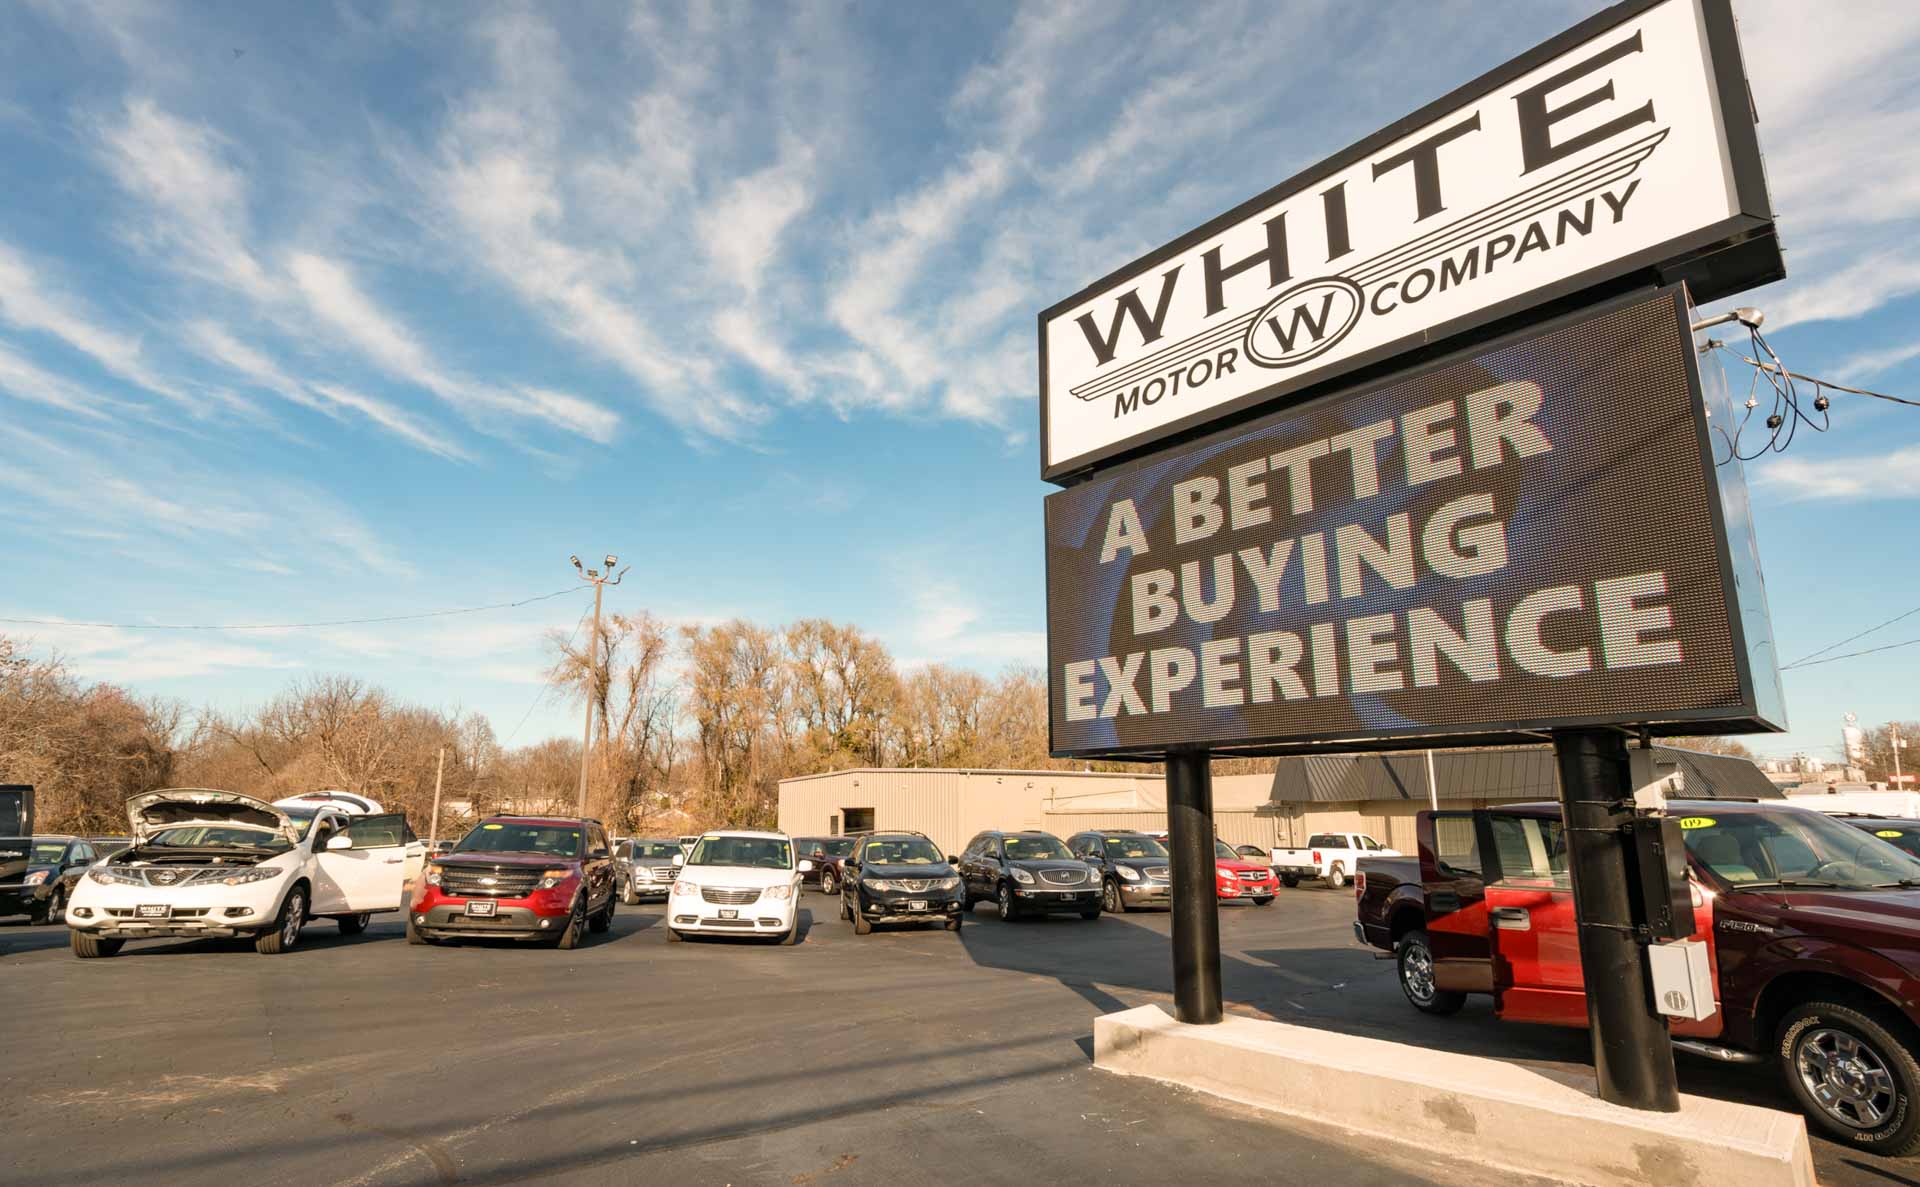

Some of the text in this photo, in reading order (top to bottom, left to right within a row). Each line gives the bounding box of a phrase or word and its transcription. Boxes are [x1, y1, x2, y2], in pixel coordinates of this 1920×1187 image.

[1074, 28, 1656, 367] WHITE
[1113, 178, 1641, 418] MOTOR COMPANY
[1266, 291, 1337, 354] W
[1100, 380, 1553, 564] A BETTER
[1064, 572, 1683, 721] EXPERIENCE
[1131, 493, 1508, 635] BUYING
